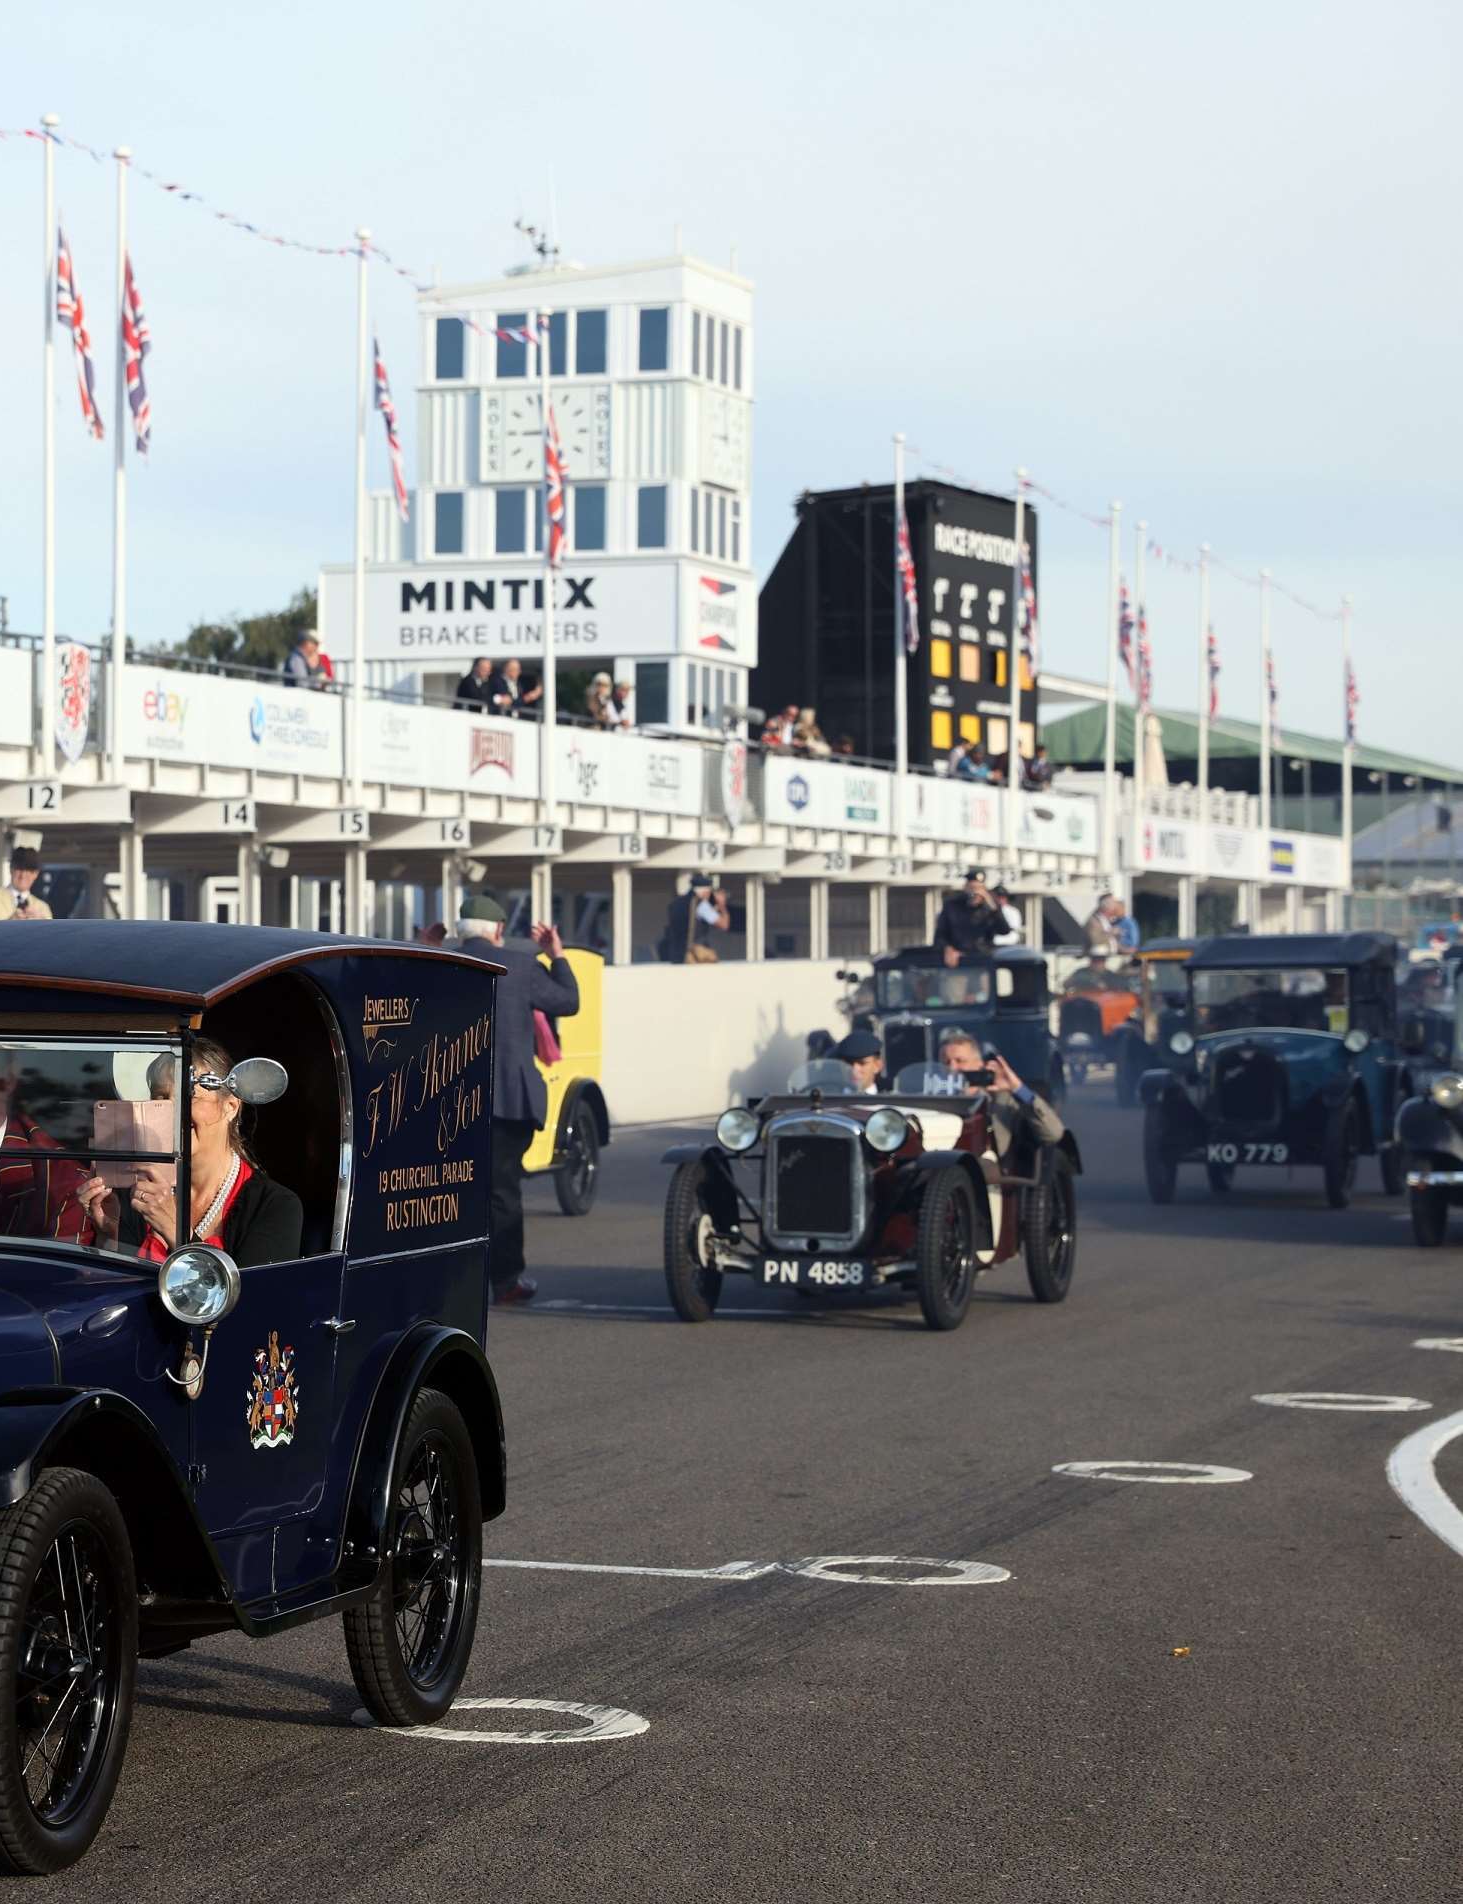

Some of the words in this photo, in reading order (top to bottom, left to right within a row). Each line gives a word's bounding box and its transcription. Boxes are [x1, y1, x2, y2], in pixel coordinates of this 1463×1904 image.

[401, 577, 596, 613] MINTEX
[400, 624, 488, 647] BRAKE
[143, 680, 189, 733] ebay
[29, 786, 54, 809] 12
[223, 804, 248, 825] 14
[340, 813, 363, 834] 15
[441, 821, 464, 841] 16
[534, 828, 555, 848] 17
[619, 834, 641, 855] 18
[698, 841, 718, 860] 19
[363, 995, 409, 1022] JEWELLERS
[414, 1012, 490, 1112] Skinner
[449, 1079, 481, 1142] Son
[1243, 1143, 1288, 1163] 779
[379, 1170, 388, 1193] 19
[390, 1164, 439, 1192] CHURCHILL
[442, 1159, 474, 1188] PARADE
[387, 1193, 459, 1231] RUSTINGTON
[764, 1260, 799, 1283] PN
[808, 1261, 863, 1285] 4858
